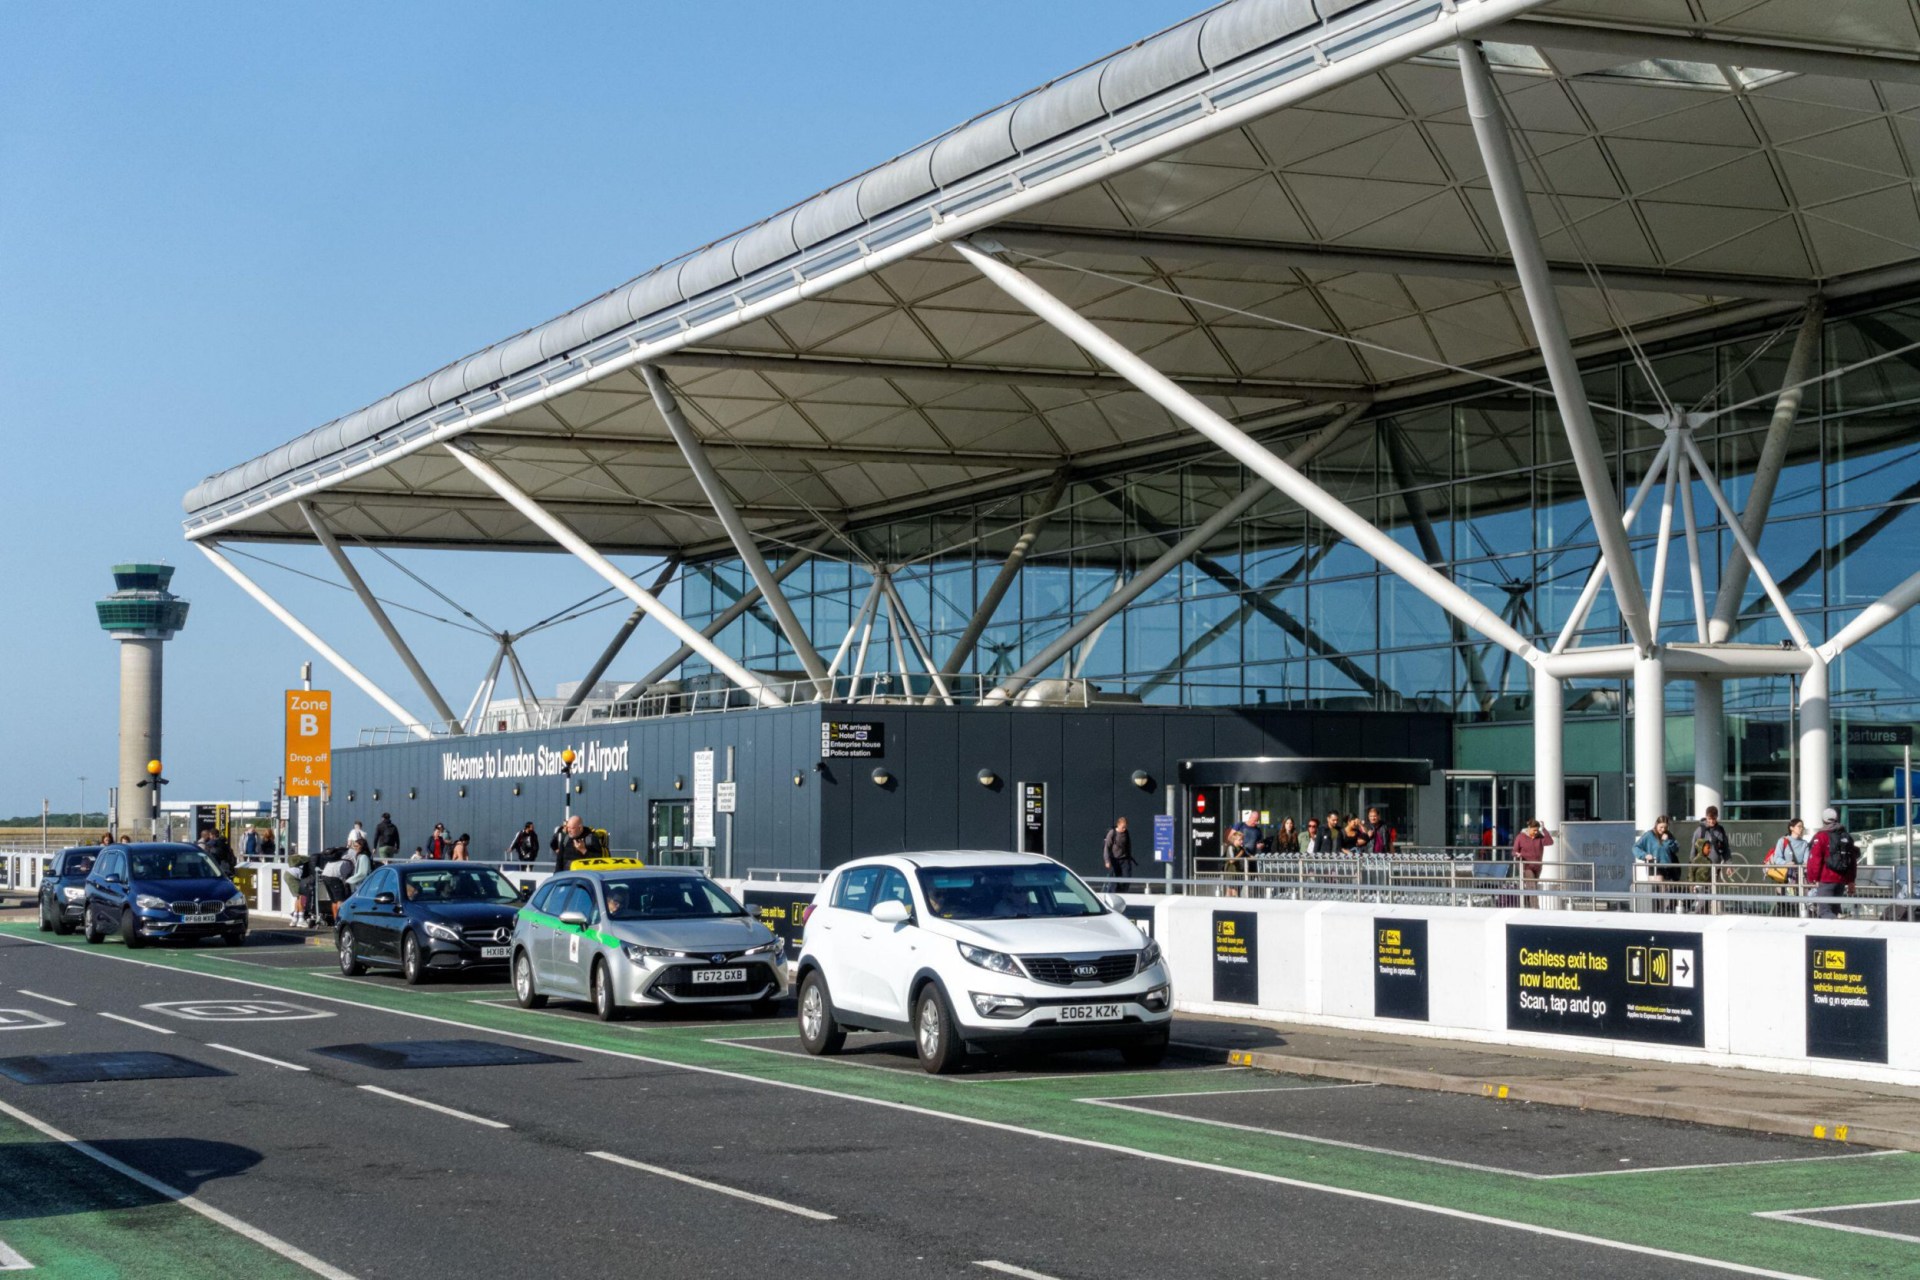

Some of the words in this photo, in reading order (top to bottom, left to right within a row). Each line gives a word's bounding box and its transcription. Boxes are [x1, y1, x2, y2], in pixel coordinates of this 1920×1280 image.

[291, 696, 328, 711] Zone
[300, 713, 319, 736] B
[1833, 729, 1897, 742] Dpartures
[830, 740, 861, 748] Enterprise
[861, 740, 881, 748] house
[289, 753, 313, 763] Drop
[314, 752, 327, 762] off
[830, 749, 849, 757] Police
[849, 749, 872, 757] station
[443, 751, 484, 780] Welcome
[485, 751, 496, 779] to
[498, 747, 535, 778] London
[538, 741, 585, 776] Staned
[587, 740, 629, 781] Airport
[304, 765, 312, 774] &
[292, 776, 310, 786] Pick
[1728, 832, 1762, 847] MOKING
[1519, 948, 1566, 968] Cashless
[1567, 951, 1587, 969] exit
[1588, 952, 1608, 971] has
[697, 970, 723, 982] FG72
[724, 969, 743, 980] GXB
[1519, 973, 1541, 987] now
[1542, 971, 1581, 990] landed.
[1813, 969, 1822, 980] Do
[1822, 971, 1833, 980] not
[1833, 971, 1848, 981] leave
[1848, 974, 1863, 983] your
[1813, 983, 1834, 993] vehicle
[1061, 1006, 1093, 1019] EO62
[1095, 1004, 1118, 1018] KZK
[1520, 991, 1548, 1013] Scan,
[1550, 994, 1568, 1016] tap
[1569, 996, 1590, 1014] and
[1592, 1000, 1607, 1018] go
